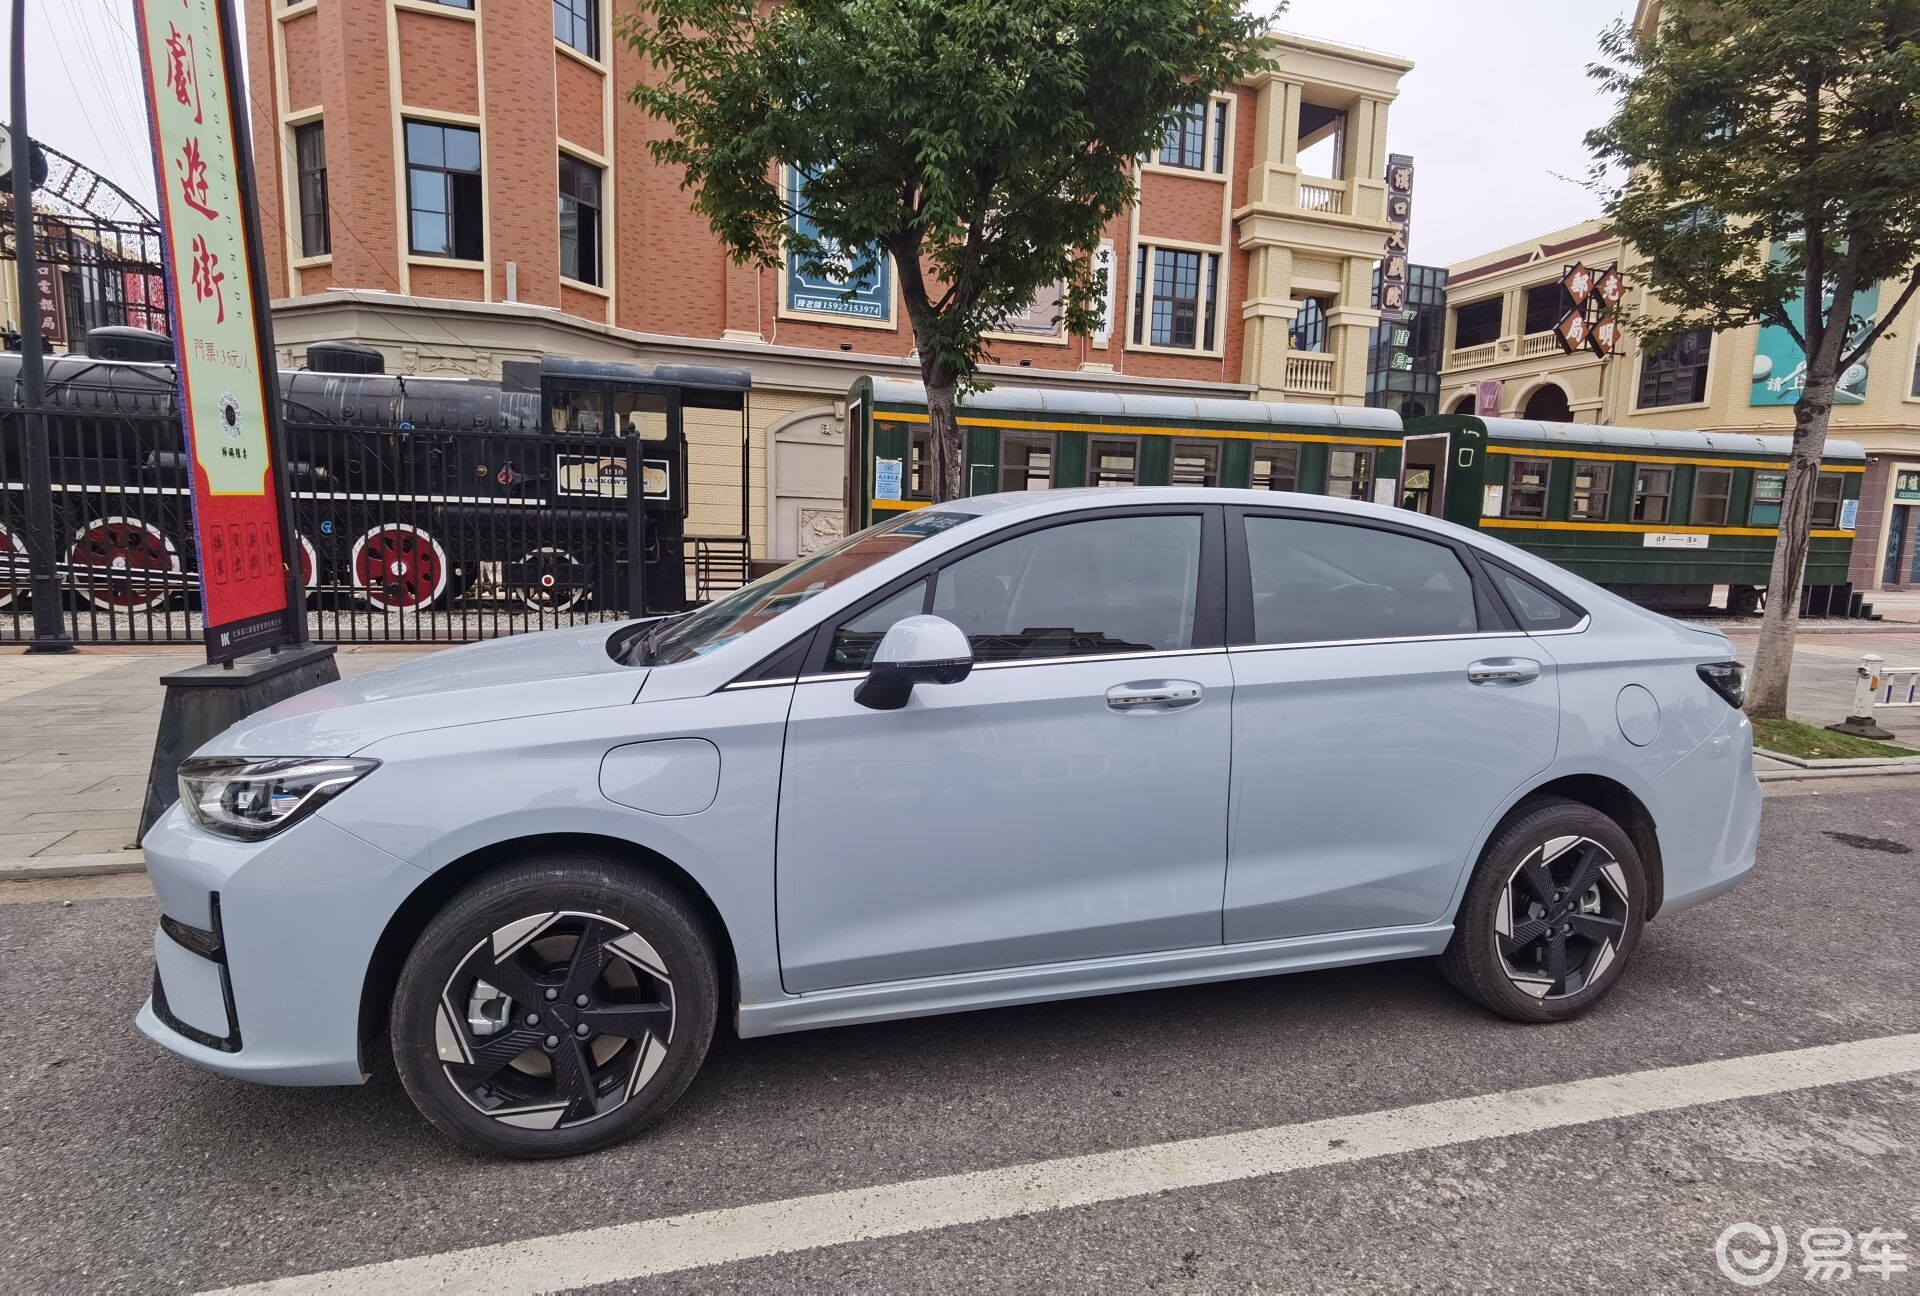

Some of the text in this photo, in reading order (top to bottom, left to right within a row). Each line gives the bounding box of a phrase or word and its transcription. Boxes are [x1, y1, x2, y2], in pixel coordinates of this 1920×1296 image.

[165, 0, 226, 325] 劇遊街
[213, 113, 229, 201] OPERA
[225, 215, 244, 321] PARADE
